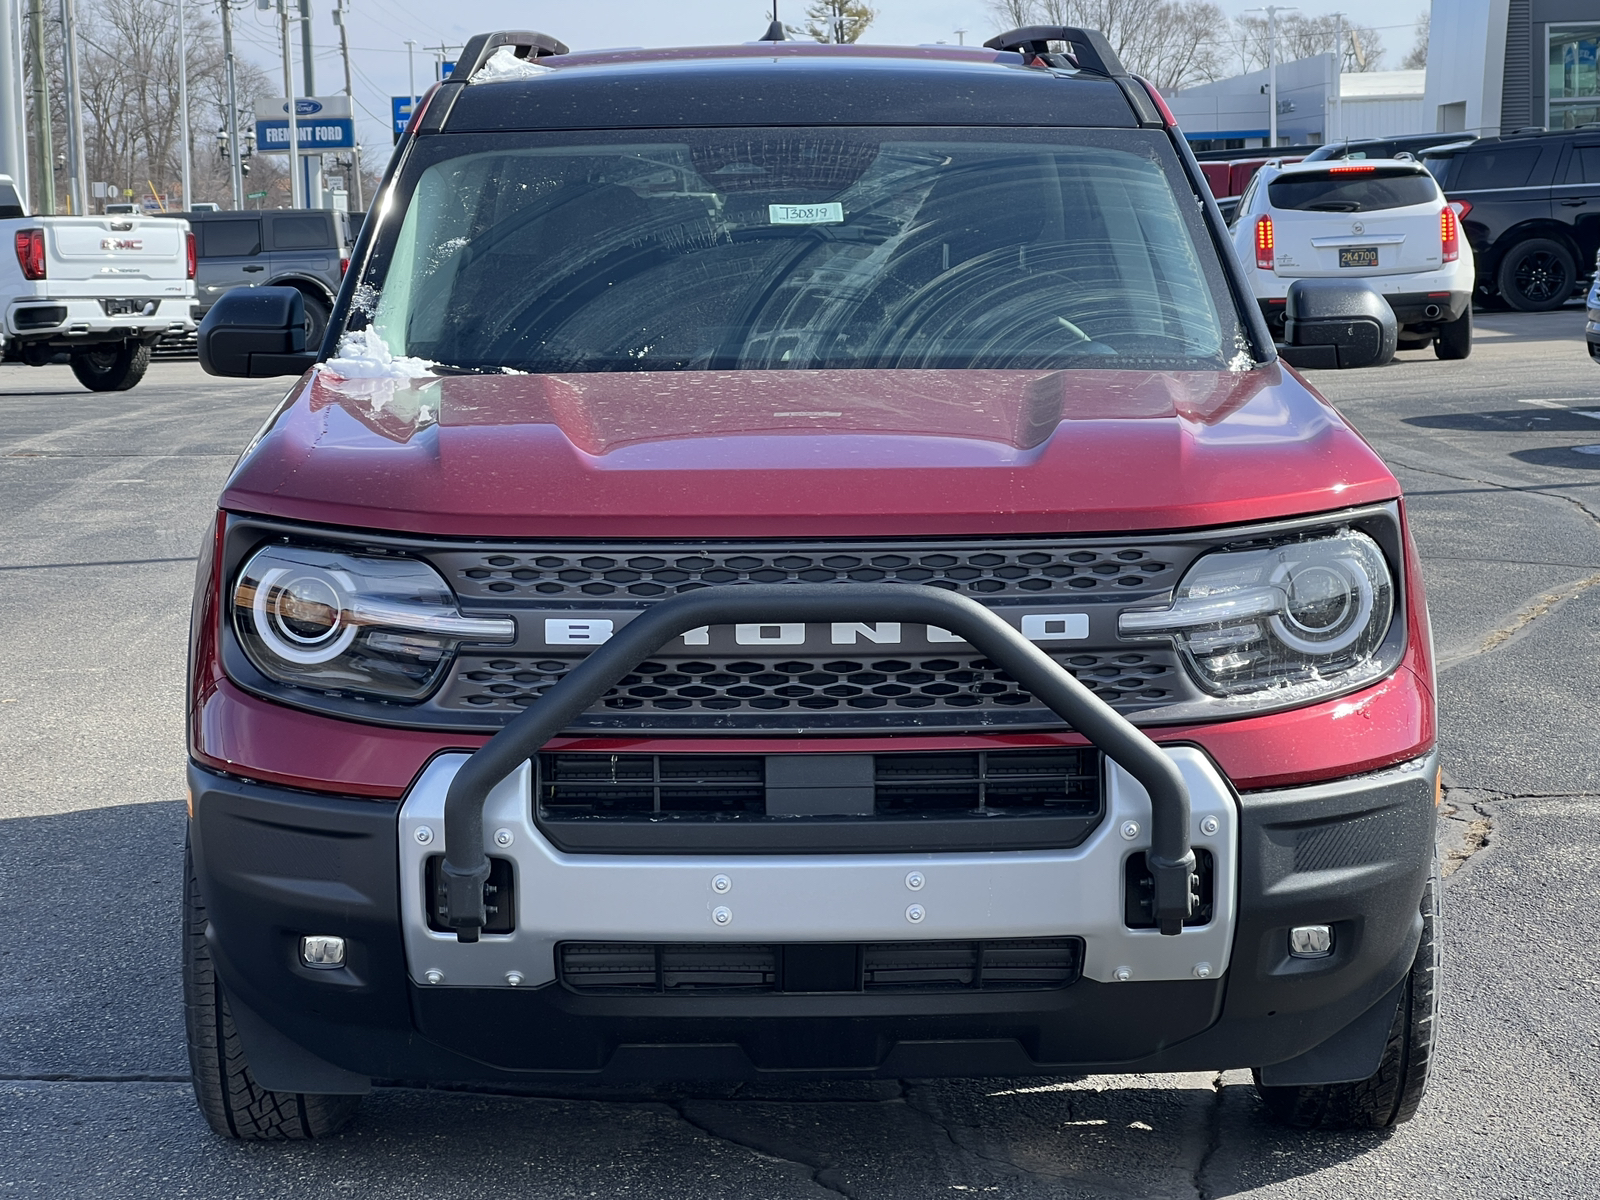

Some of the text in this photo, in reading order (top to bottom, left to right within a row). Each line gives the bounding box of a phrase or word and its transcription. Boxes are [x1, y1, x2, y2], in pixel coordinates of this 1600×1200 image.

[315, 126, 343, 141] FORD
[1341, 251, 1376, 262] 2K4700
[544, 613, 1090, 645] BONO
